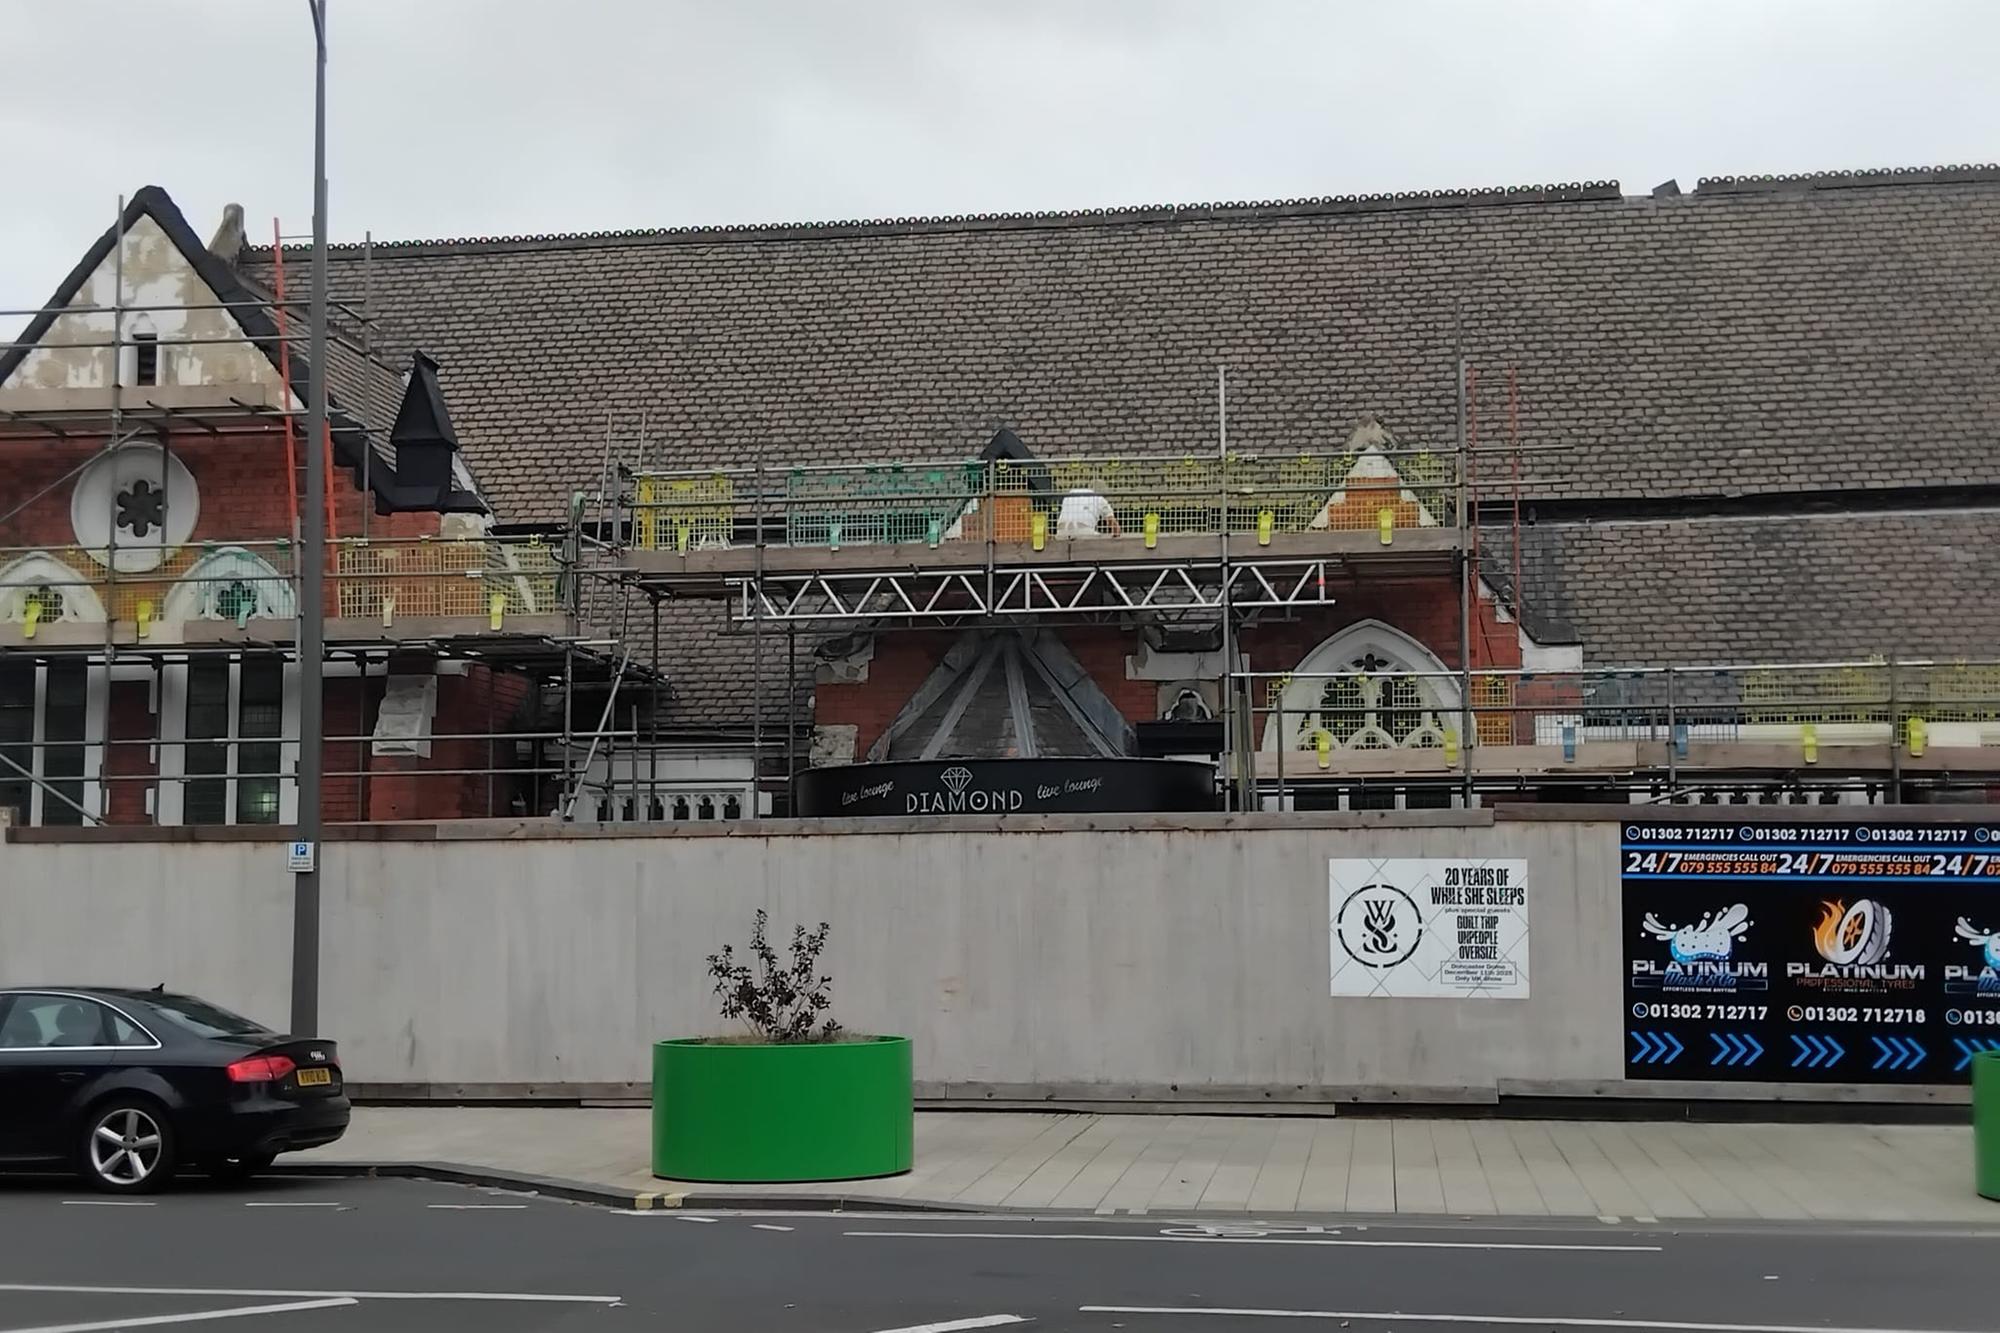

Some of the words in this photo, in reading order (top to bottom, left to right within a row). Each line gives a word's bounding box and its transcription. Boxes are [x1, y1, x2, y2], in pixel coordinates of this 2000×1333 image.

[906, 790, 1023, 813] DIAMOND
[1642, 829, 1682, 840] 01302
[1686, 829, 1734, 840] 712717
[1755, 829, 1797, 841] 01302
[1801, 829, 1849, 841] 712717
[1872, 829, 1914, 841] 01302
[1917, 830, 1967, 841] 712717
[1626, 852, 1683, 873] 24/7
[1684, 853, 1738, 862] EMERGENCIES
[1739, 854, 1759, 862] CALL
[1760, 854, 1778, 862] OUT
[1777, 853, 1834, 875] 24/7
[1835, 855, 1891, 863] EMERGENCIES
[1892, 855, 1912, 863] CALL
[1913, 855, 1931, 863] OUT
[1930, 854, 1989, 876] 24/7
[1680, 862, 1705, 873] 079
[1706, 862, 1731, 873] 555
[1733, 863, 1758, 873] 555
[1760, 863, 1777, 873] 84
[1832, 863, 1856, 874] 079
[1859, 863, 1883, 874] 555
[1886, 864, 1911, 875] 555
[1913, 864, 1931, 875] 84
[1445, 868, 1459, 886] 20
[1461, 868, 1494, 886] YEARS
[1496, 868, 1509, 886] OF
[1431, 887, 1463, 905] WHILE
[1464, 887, 1485, 905] SHE
[1486, 887, 1524, 905] SLEEPS
[1457, 915, 1479, 929] GUILT
[1480, 915, 1499, 929] TRIP
[1457, 930, 1498, 945] UNPEOPLE
[1459, 945, 1498, 960] OVERSIZE
[1632, 960, 1768, 977] PLATINUM
[1787, 962, 1925, 980] PLATINUM
[1796, 978, 1876, 988] PROFESSIONAL
[1882, 979, 1916, 989] TYRES
[1650, 1004, 1702, 1018] 01302
[1706, 1005, 1768, 1020] 712717
[1805, 1006, 1858, 1022] 01302
[1863, 1008, 1926, 1023] 712718
